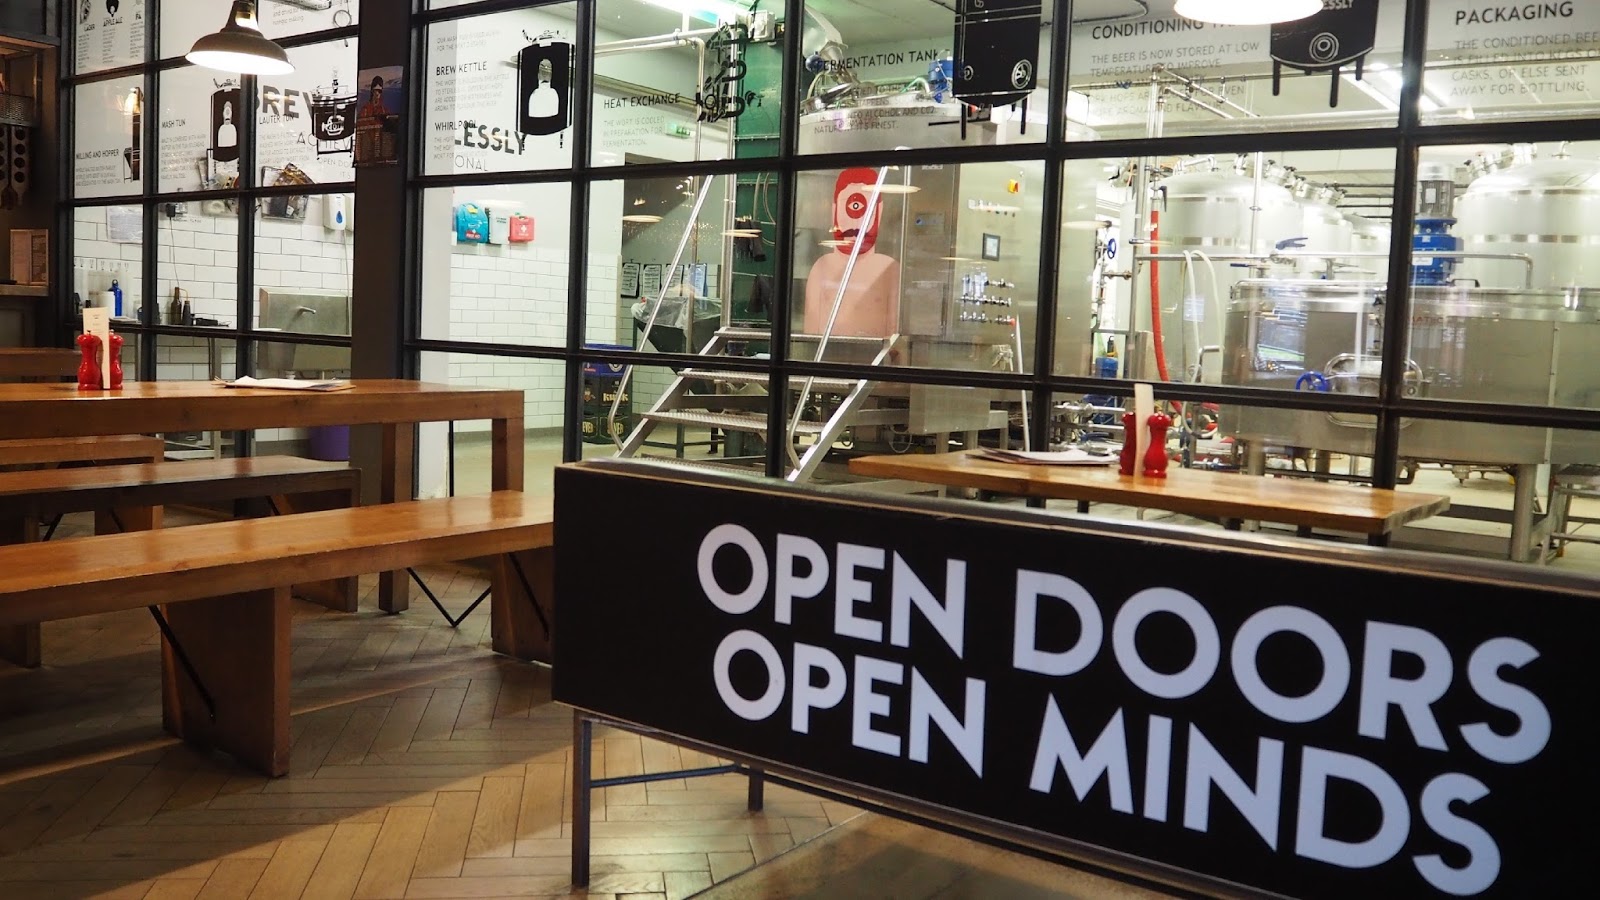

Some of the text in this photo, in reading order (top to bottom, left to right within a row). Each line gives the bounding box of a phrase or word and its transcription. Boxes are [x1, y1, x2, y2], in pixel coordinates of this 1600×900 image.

[1455, 1, 1574, 25] PACKAGING
[1092, 18, 1204, 40] CONDITIONING
[1454, 38, 1479, 50] THE
[1483, 33, 1570, 49] CONDITIONED
[1092, 42, 1260, 64] THE BEER IS NOW STORED AT LOW
[436, 60, 488, 76] BREW KETTLE
[1091, 63, 1156, 77] TEMPERATUR
[1521, 65, 1549, 78] ELSE
[1556, 64, 1588, 77] SENT
[1450, 84, 1486, 97] AWAY
[1492, 83, 1516, 95] FOR
[604, 92, 681, 109] HEAT EXCHANGE
[697, 523, 1551, 764] OPEN DOORS
[713, 629, 1501, 896] OPEN MINDS
